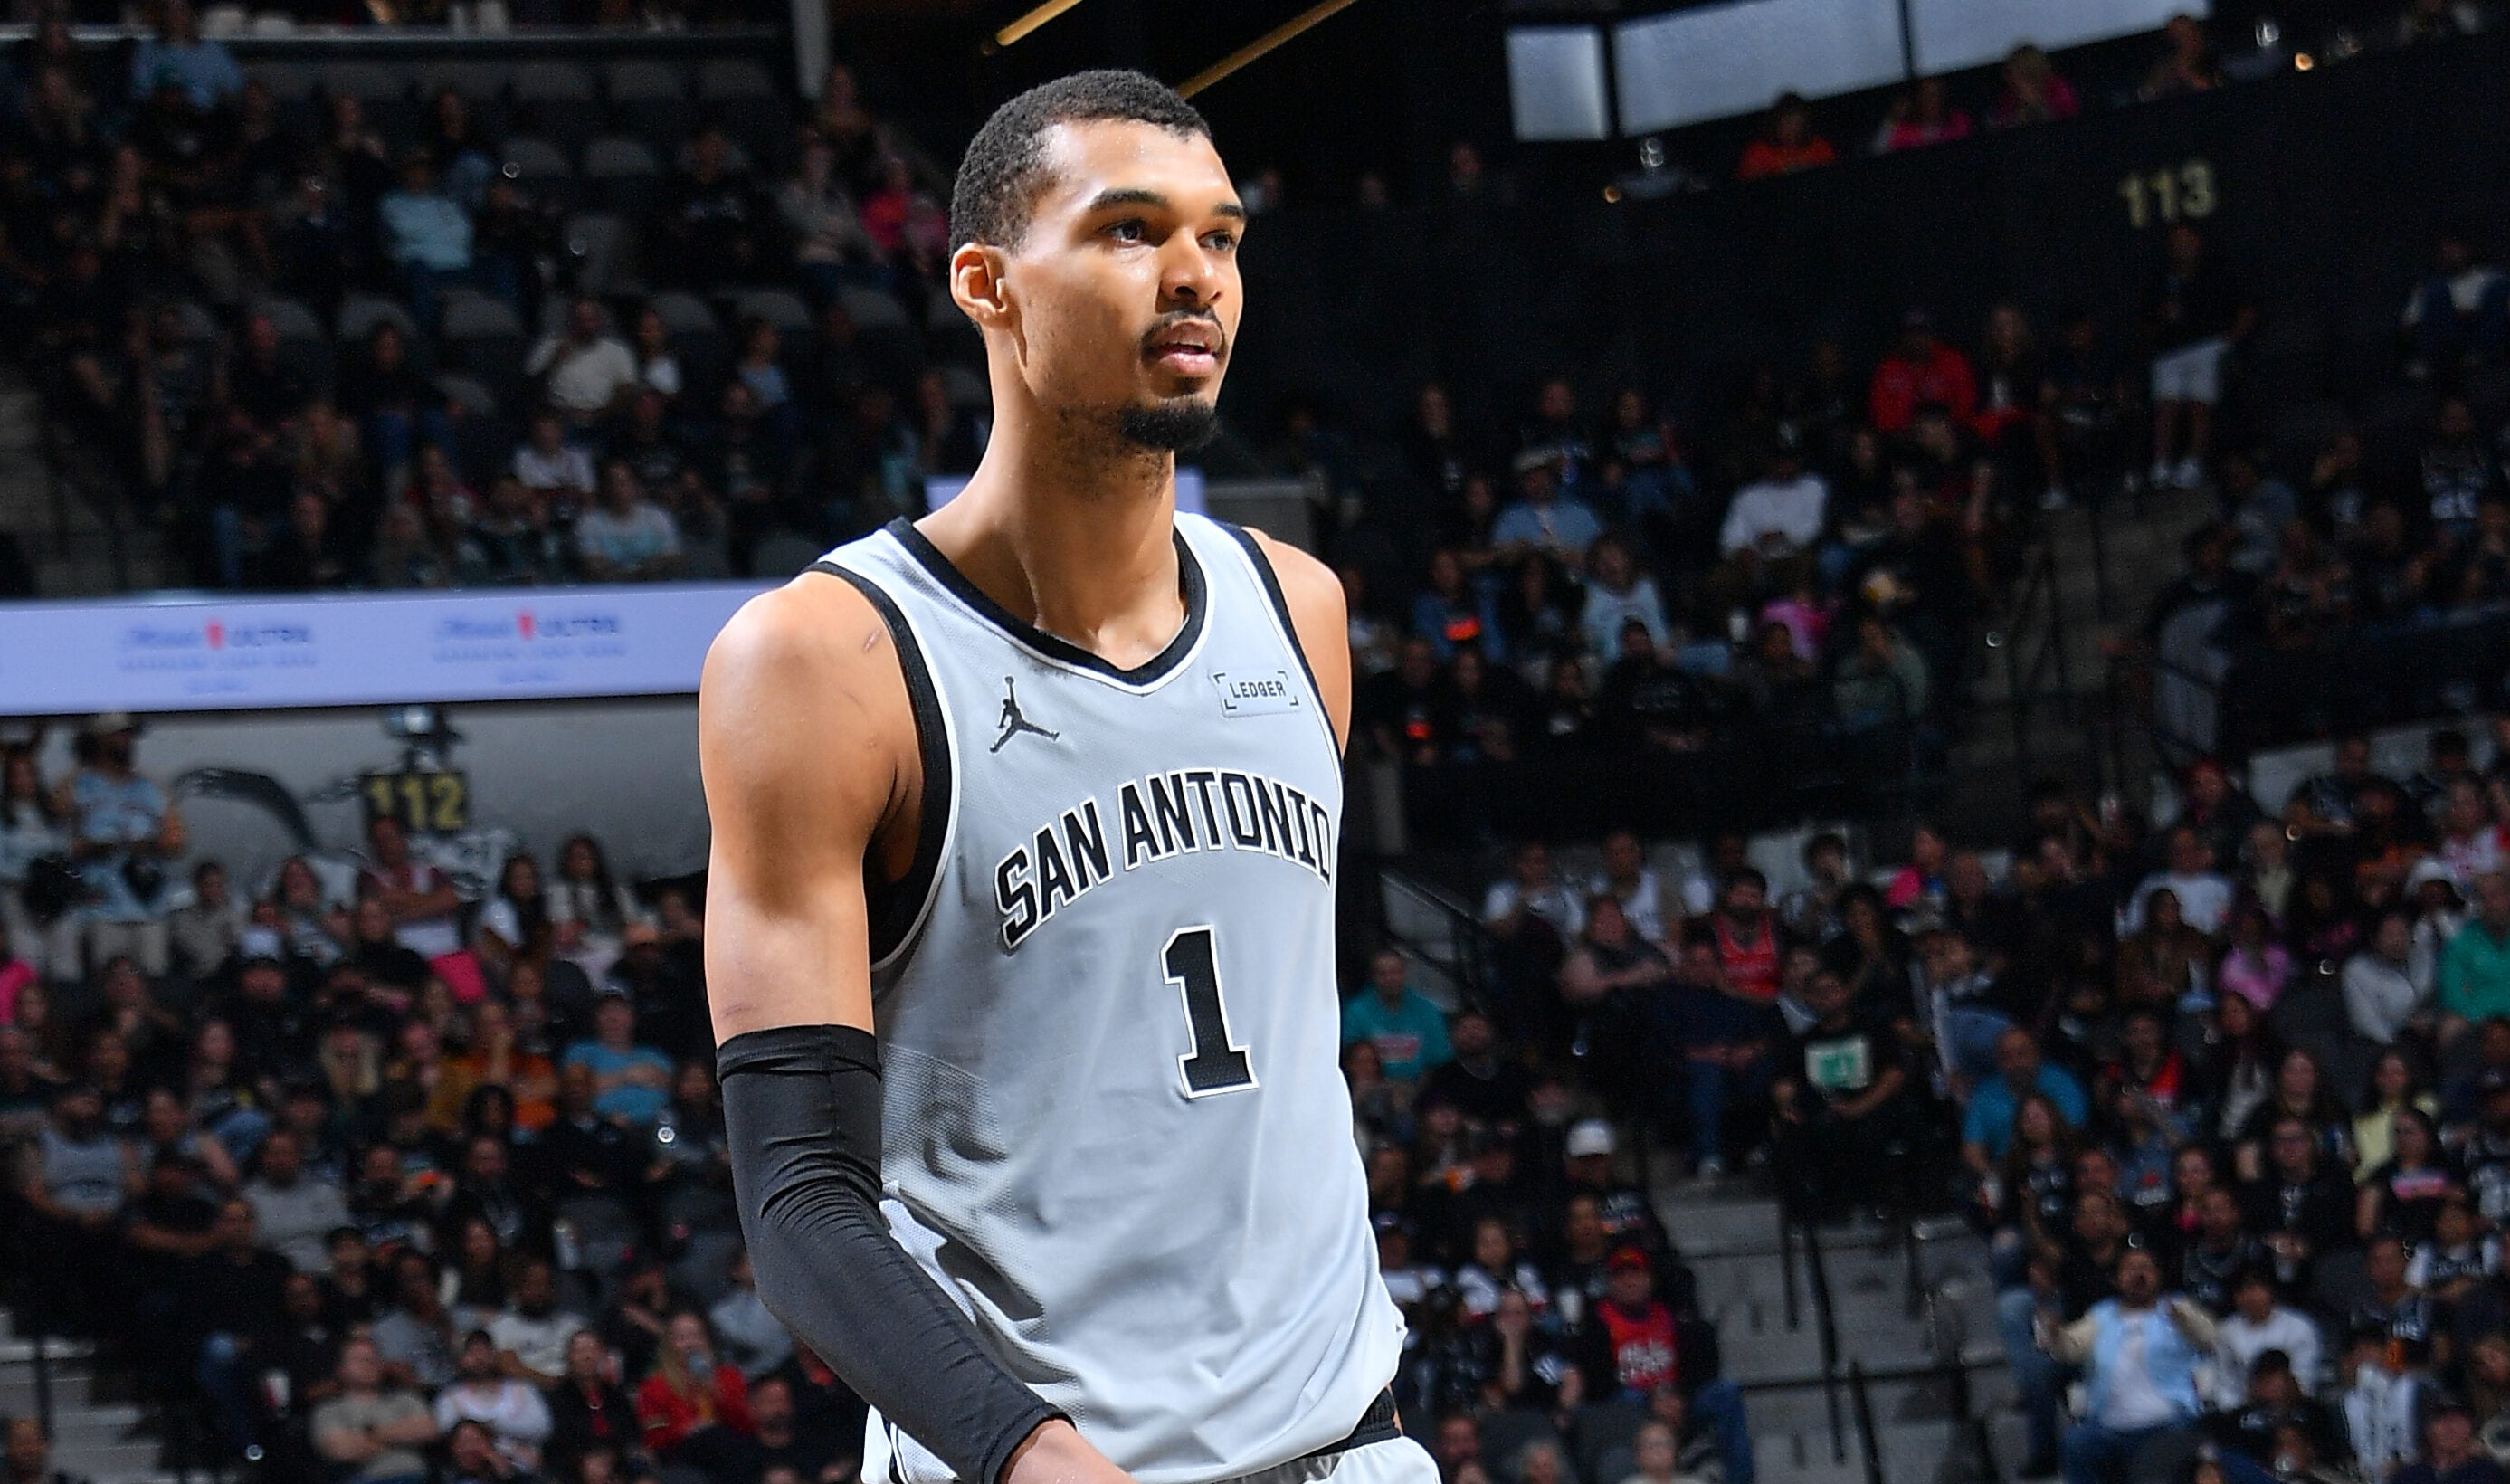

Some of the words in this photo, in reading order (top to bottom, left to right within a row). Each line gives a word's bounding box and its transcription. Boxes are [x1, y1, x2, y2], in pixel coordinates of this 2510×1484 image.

[2121, 164, 2213, 226] 113
[1229, 680, 1286, 699] LEDGER
[370, 775, 464, 830] 112
[994, 796, 1113, 951] SAN
[1117, 768, 1331, 891] ANTONIO
[1160, 924, 1260, 1098] 1
